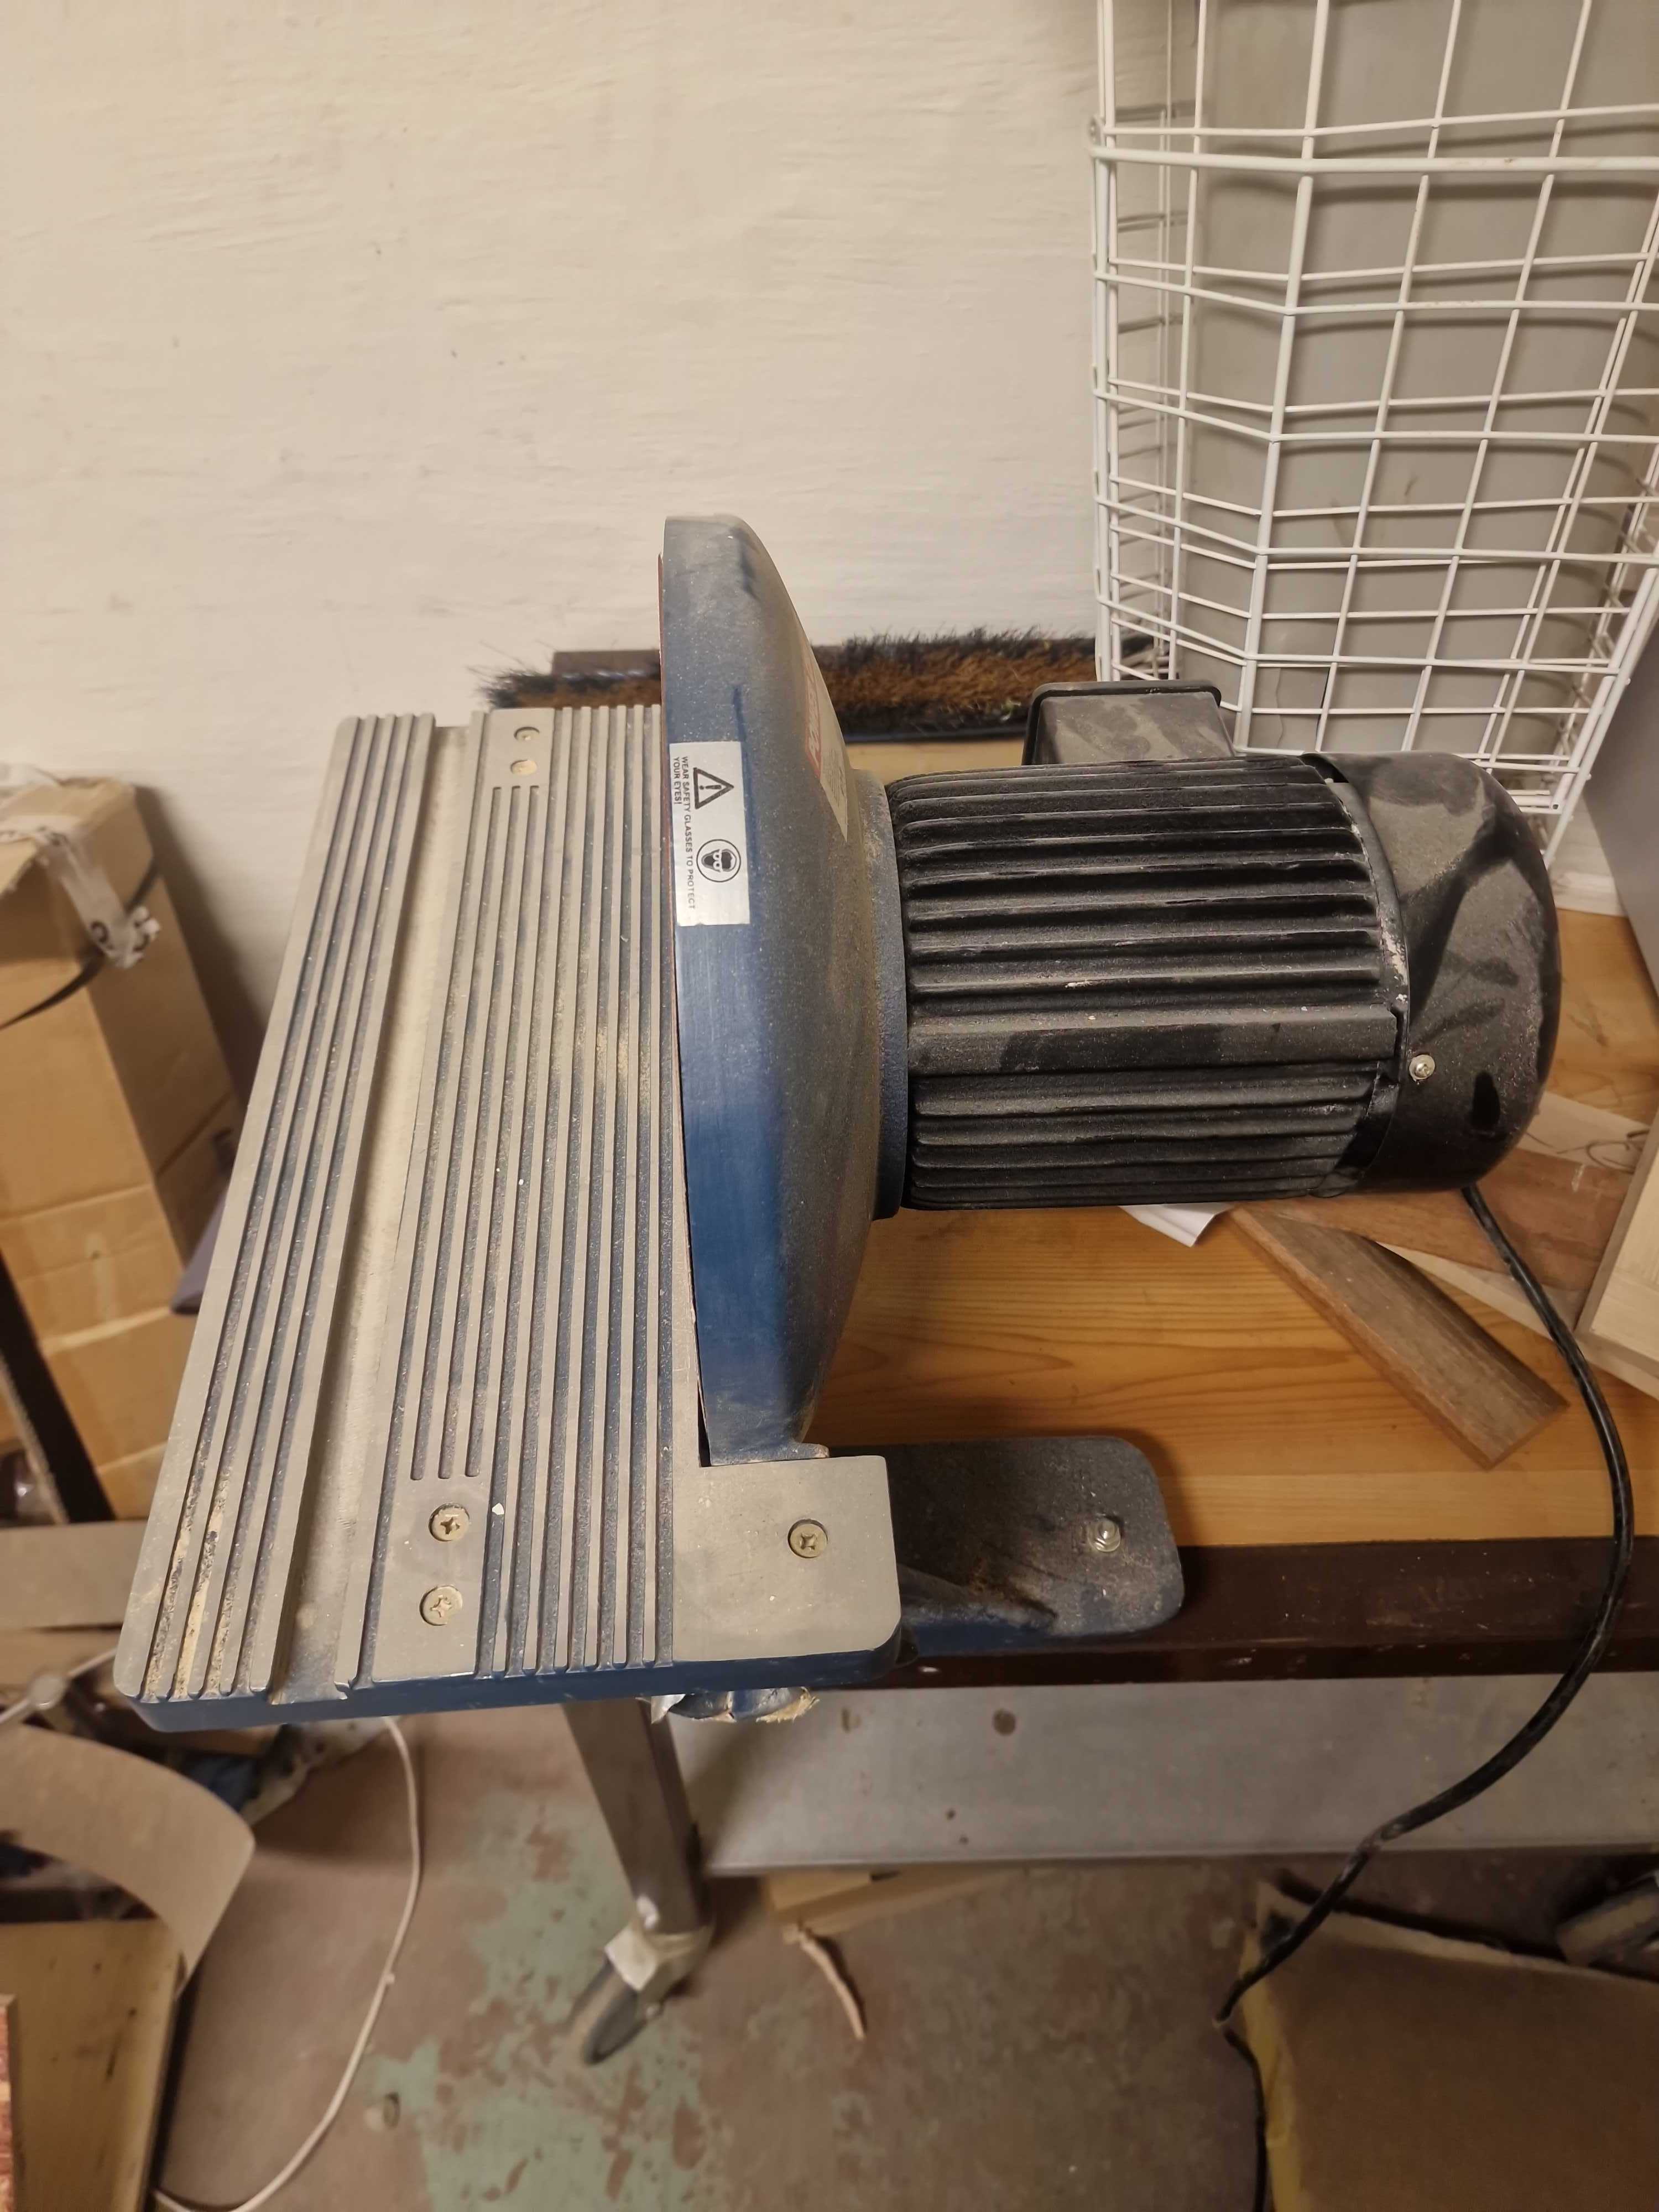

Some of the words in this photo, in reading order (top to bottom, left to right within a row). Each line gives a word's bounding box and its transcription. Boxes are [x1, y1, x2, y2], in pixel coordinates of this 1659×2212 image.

[674, 781, 682, 804] EYES!
[682, 781, 691, 812] SAFETY
[684, 815, 693, 853] GLASSES
[686, 855, 693, 867] TO
